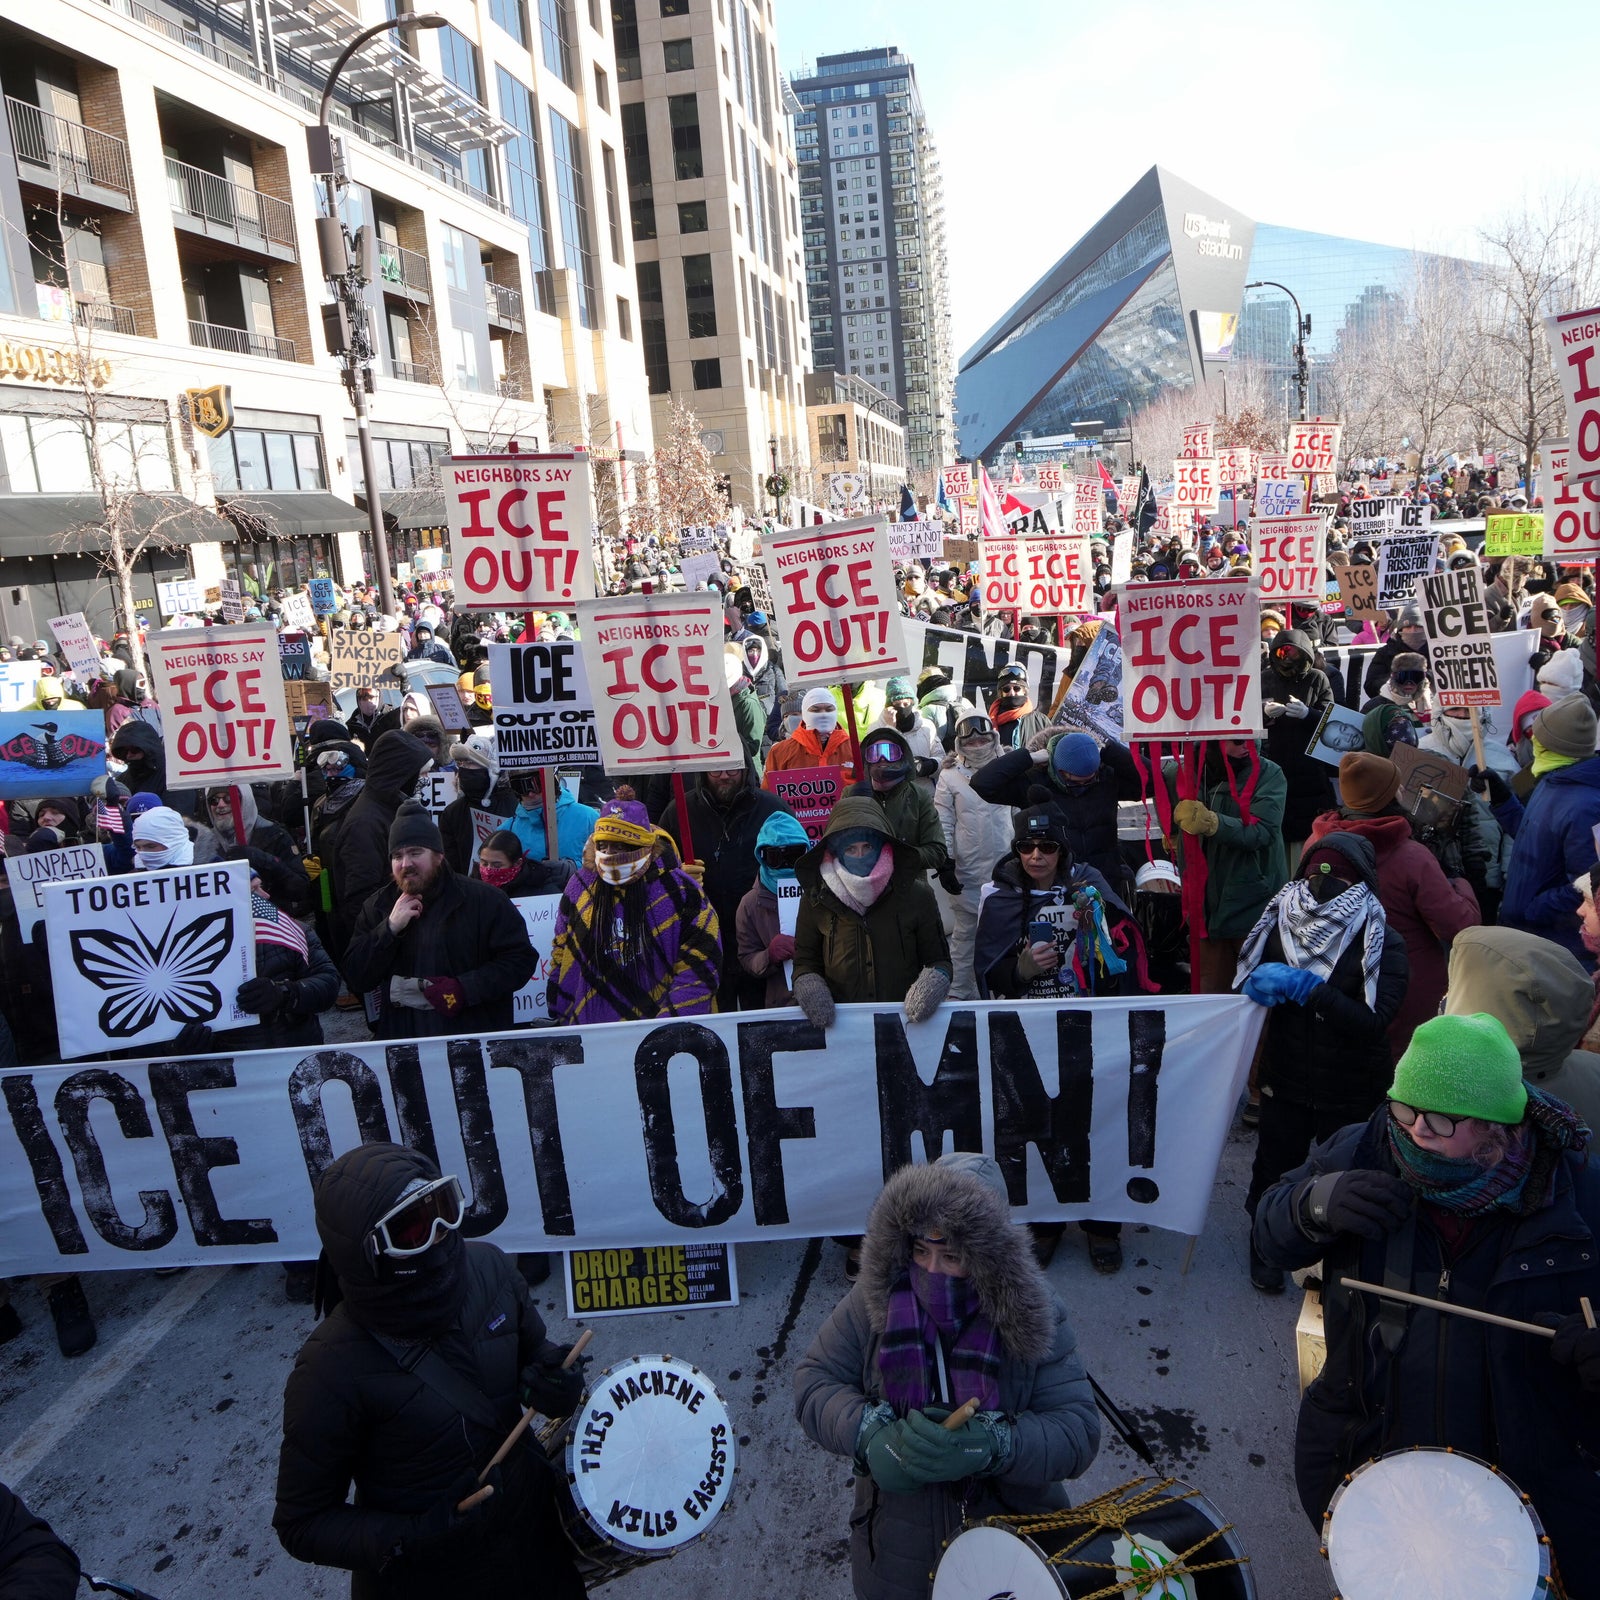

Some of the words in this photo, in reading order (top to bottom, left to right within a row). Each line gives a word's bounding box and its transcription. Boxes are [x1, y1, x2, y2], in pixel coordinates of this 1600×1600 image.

[1199, 238, 1243, 260] stadium
[1184, 433, 1208, 446] ICE
[1294, 434, 1333, 452] ICE
[1291, 452, 1334, 470] OUT!
[454, 468, 541, 484] NEIGHBORS
[545, 469, 573, 482] SAY
[831, 475, 841, 484] ONLY
[945, 471, 968, 483] ICE
[1038, 470, 1060, 480] ICE
[1178, 467, 1210, 484] ICE
[1261, 465, 1288, 479] ICE
[945, 482, 970, 495] OUT!
[1039, 480, 1062, 489] OUT!
[1123, 483, 1139, 493] ICE
[1263, 482, 1297, 498] ICE
[1319, 478, 1335, 486] ICE
[1320, 485, 1336, 493] OUT!
[1075, 484, 1098, 497] ICE
[1178, 487, 1212, 504] OUT!
[458, 488, 569, 542] ICE
[1075, 509, 1098, 521] ICE
[1157, 506, 1170, 518] IC
[1265, 504, 1297, 516] OUT
[1353, 499, 1385, 519] STOP
[1401, 506, 1424, 527] ICE
[681, 527, 692, 537] ICE
[696, 527, 706, 537] ICE
[913, 522, 932, 531] FINE
[1075, 521, 1099, 532] OUT!
[1153, 519, 1169, 530] OU
[1260, 526, 1302, 536] NEIGHBORS
[1304, 525, 1319, 533] SAY
[1352, 522, 1362, 530] ICE
[1362, 519, 1385, 530] TERROR
[1353, 528, 1386, 536] NOW!
[1553, 510, 1600, 543] OU
[889, 534, 907, 545] DUDE
[924, 530, 942, 542] NOT
[1383, 535, 1438, 546] ARREST
[776, 544, 850, 570] NEIGHBORS
[852, 540, 875, 556] SAY
[889, 545, 910, 555] MAD
[911, 545, 920, 554] AT
[922, 543, 937, 553] YOU
[1026, 543, 1066, 554] NEIGHBORS
[1066, 542, 1084, 551] SAY
[1259, 536, 1315, 564] ICE
[1386, 543, 1433, 559] JONATHAN
[463, 545, 579, 598] OUT!
[986, 553, 1020, 578] IC
[1028, 553, 1082, 582] ICE
[1387, 558, 1411, 572] ROSS
[1411, 556, 1429, 570] FOR
[749, 568, 763, 580] ICE
[1259, 567, 1318, 594] OUT!
[165, 581, 196, 598] ICE
[313, 582, 330, 591] ICE
[750, 578, 765, 589] OUT
[781, 559, 881, 615] ICE
[1422, 569, 1479, 609] KILLER
[313, 590, 333, 599] OUT
[986, 581, 1021, 604] OU
[1030, 583, 1087, 610] OUT!
[165, 598, 199, 613] OUT
[287, 597, 307, 612] ICE
[1127, 594, 1216, 614] NEIGHBORS
[1218, 592, 1246, 607] SAY
[1320, 602, 1342, 613] MSP
[1352, 592, 1377, 611] Out
[1424, 602, 1488, 639] ICE
[335, 630, 385, 647] STOP
[597, 626, 680, 645] NEIGHBORS
[684, 624, 710, 638] SAY
[792, 610, 890, 663] OUT!
[1129, 614, 1241, 667] ICE
[333, 646, 399, 661] TAKING
[1098, 638, 1123, 665] ICE
[1433, 644, 1459, 658] OFF
[1461, 642, 1492, 656] OUR
[164, 652, 239, 670] NEIGHBORS
[242, 651, 265, 664] SAY
[357, 661, 381, 674] MY
[509, 644, 578, 705] ICE
[602, 644, 710, 697] ICE
[1434, 656, 1498, 690] STREETS
[169, 669, 266, 715] ICE
[1131, 674, 1250, 726] OUT!
[496, 712, 556, 728] OUT
[559, 710, 596, 724] OF
[612, 700, 720, 751] OUT!
[61, 735, 106, 758] OUT
[176, 718, 276, 765] OUT!
[497, 725, 598, 753] MINNESOTA
[0, 736, 35, 760] ICE
[500, 757, 519, 766] PARTY
[518, 756, 530, 765] FOR
[529, 754, 558, 765] SOCIALISM
[558, 754, 566, 763] &
[566, 752, 598, 763] LIBERATION
[776, 778, 837, 798] PROUD
[787, 798, 817, 811] HILD
[819, 795, 837, 807] OF
[473, 810, 492, 826] WE
[17, 849, 97, 881] UNPAID
[66, 870, 232, 914] TOGETHER
[778, 885, 803, 899] LEGA
[1037, 911, 1066, 924] OUT
[1036, 986, 1058, 995] ILLEGAL
[1059, 985, 1070, 993] ON
[1040, 978, 1055, 987] ONE
[0, 1058, 278, 1254] ICE
[288, 1035, 584, 1239] OUT
[633, 1019, 827, 1227] OF
[873, 1009, 1166, 1206] MN!
[572, 1248, 635, 1281] DROP
[642, 1244, 687, 1275] THE
[687, 1271, 706, 1280] ALLEN
[575, 1273, 689, 1309] CHARGES
[688, 1284, 715, 1293] WILLIAM
[689, 1292, 707, 1301] KELLY
[580, 1408, 614, 1473] THIS
[608, 1370, 706, 1414] MACHINE
[606, 1499, 678, 1537] KILLS
[683, 1423, 728, 1520] FASCISTS
